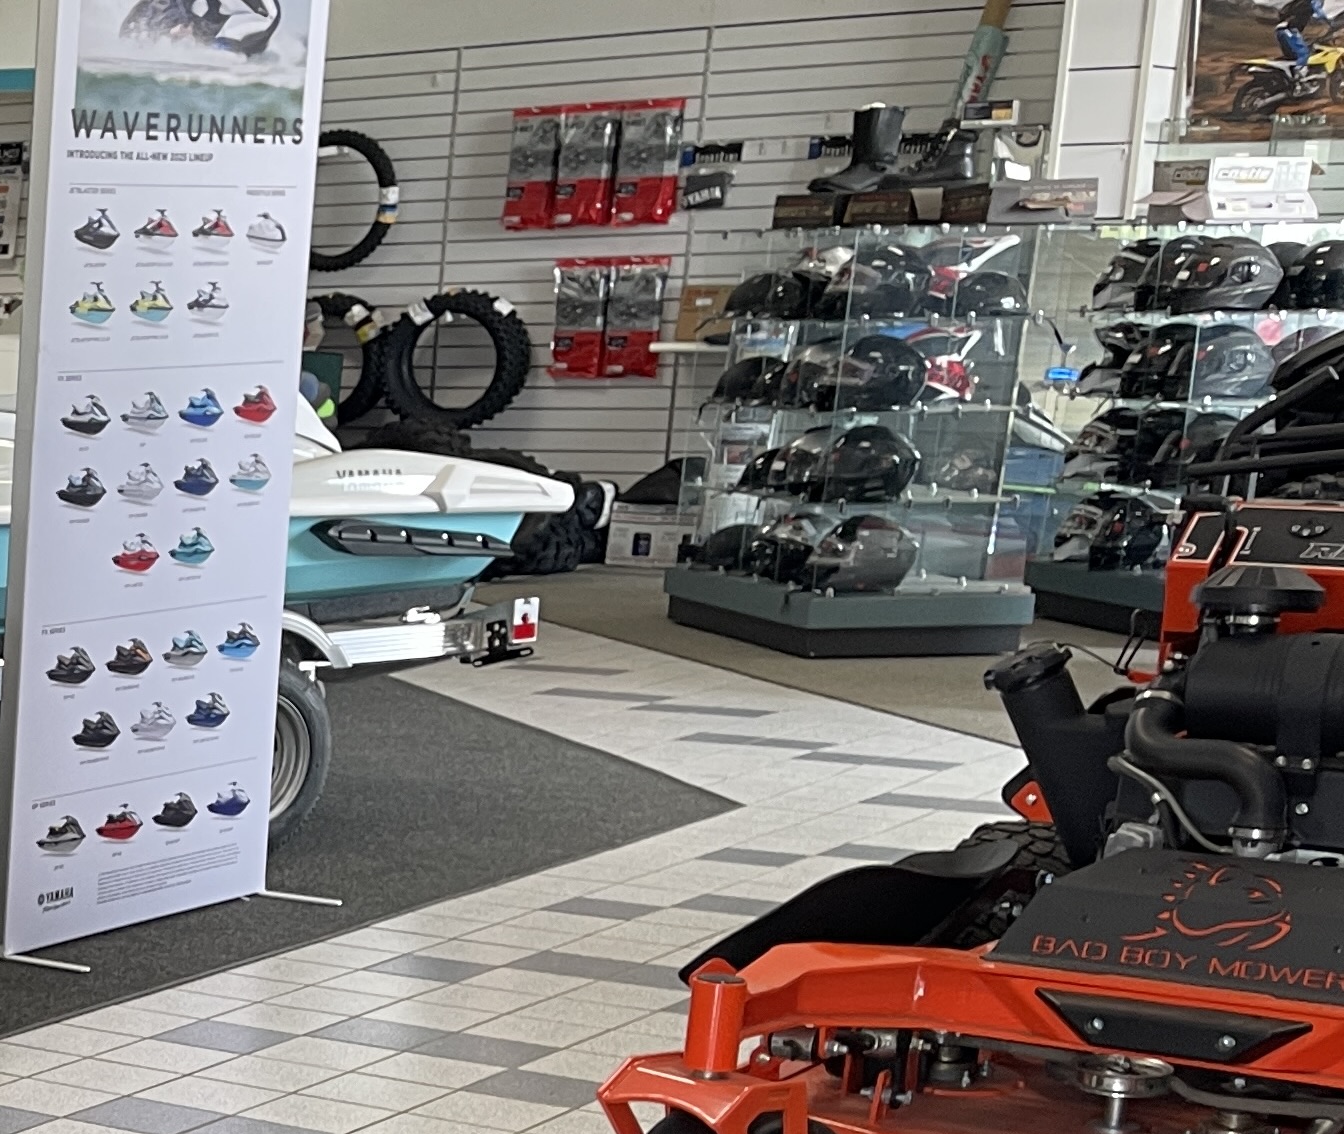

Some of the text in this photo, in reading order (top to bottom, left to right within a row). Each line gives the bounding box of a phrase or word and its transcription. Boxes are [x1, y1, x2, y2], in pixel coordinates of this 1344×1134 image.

[71, 108, 304, 145] WAVERUNNERS
[1032, 934, 1108, 961] BAD
[1120, 945, 1198, 971] BOY
